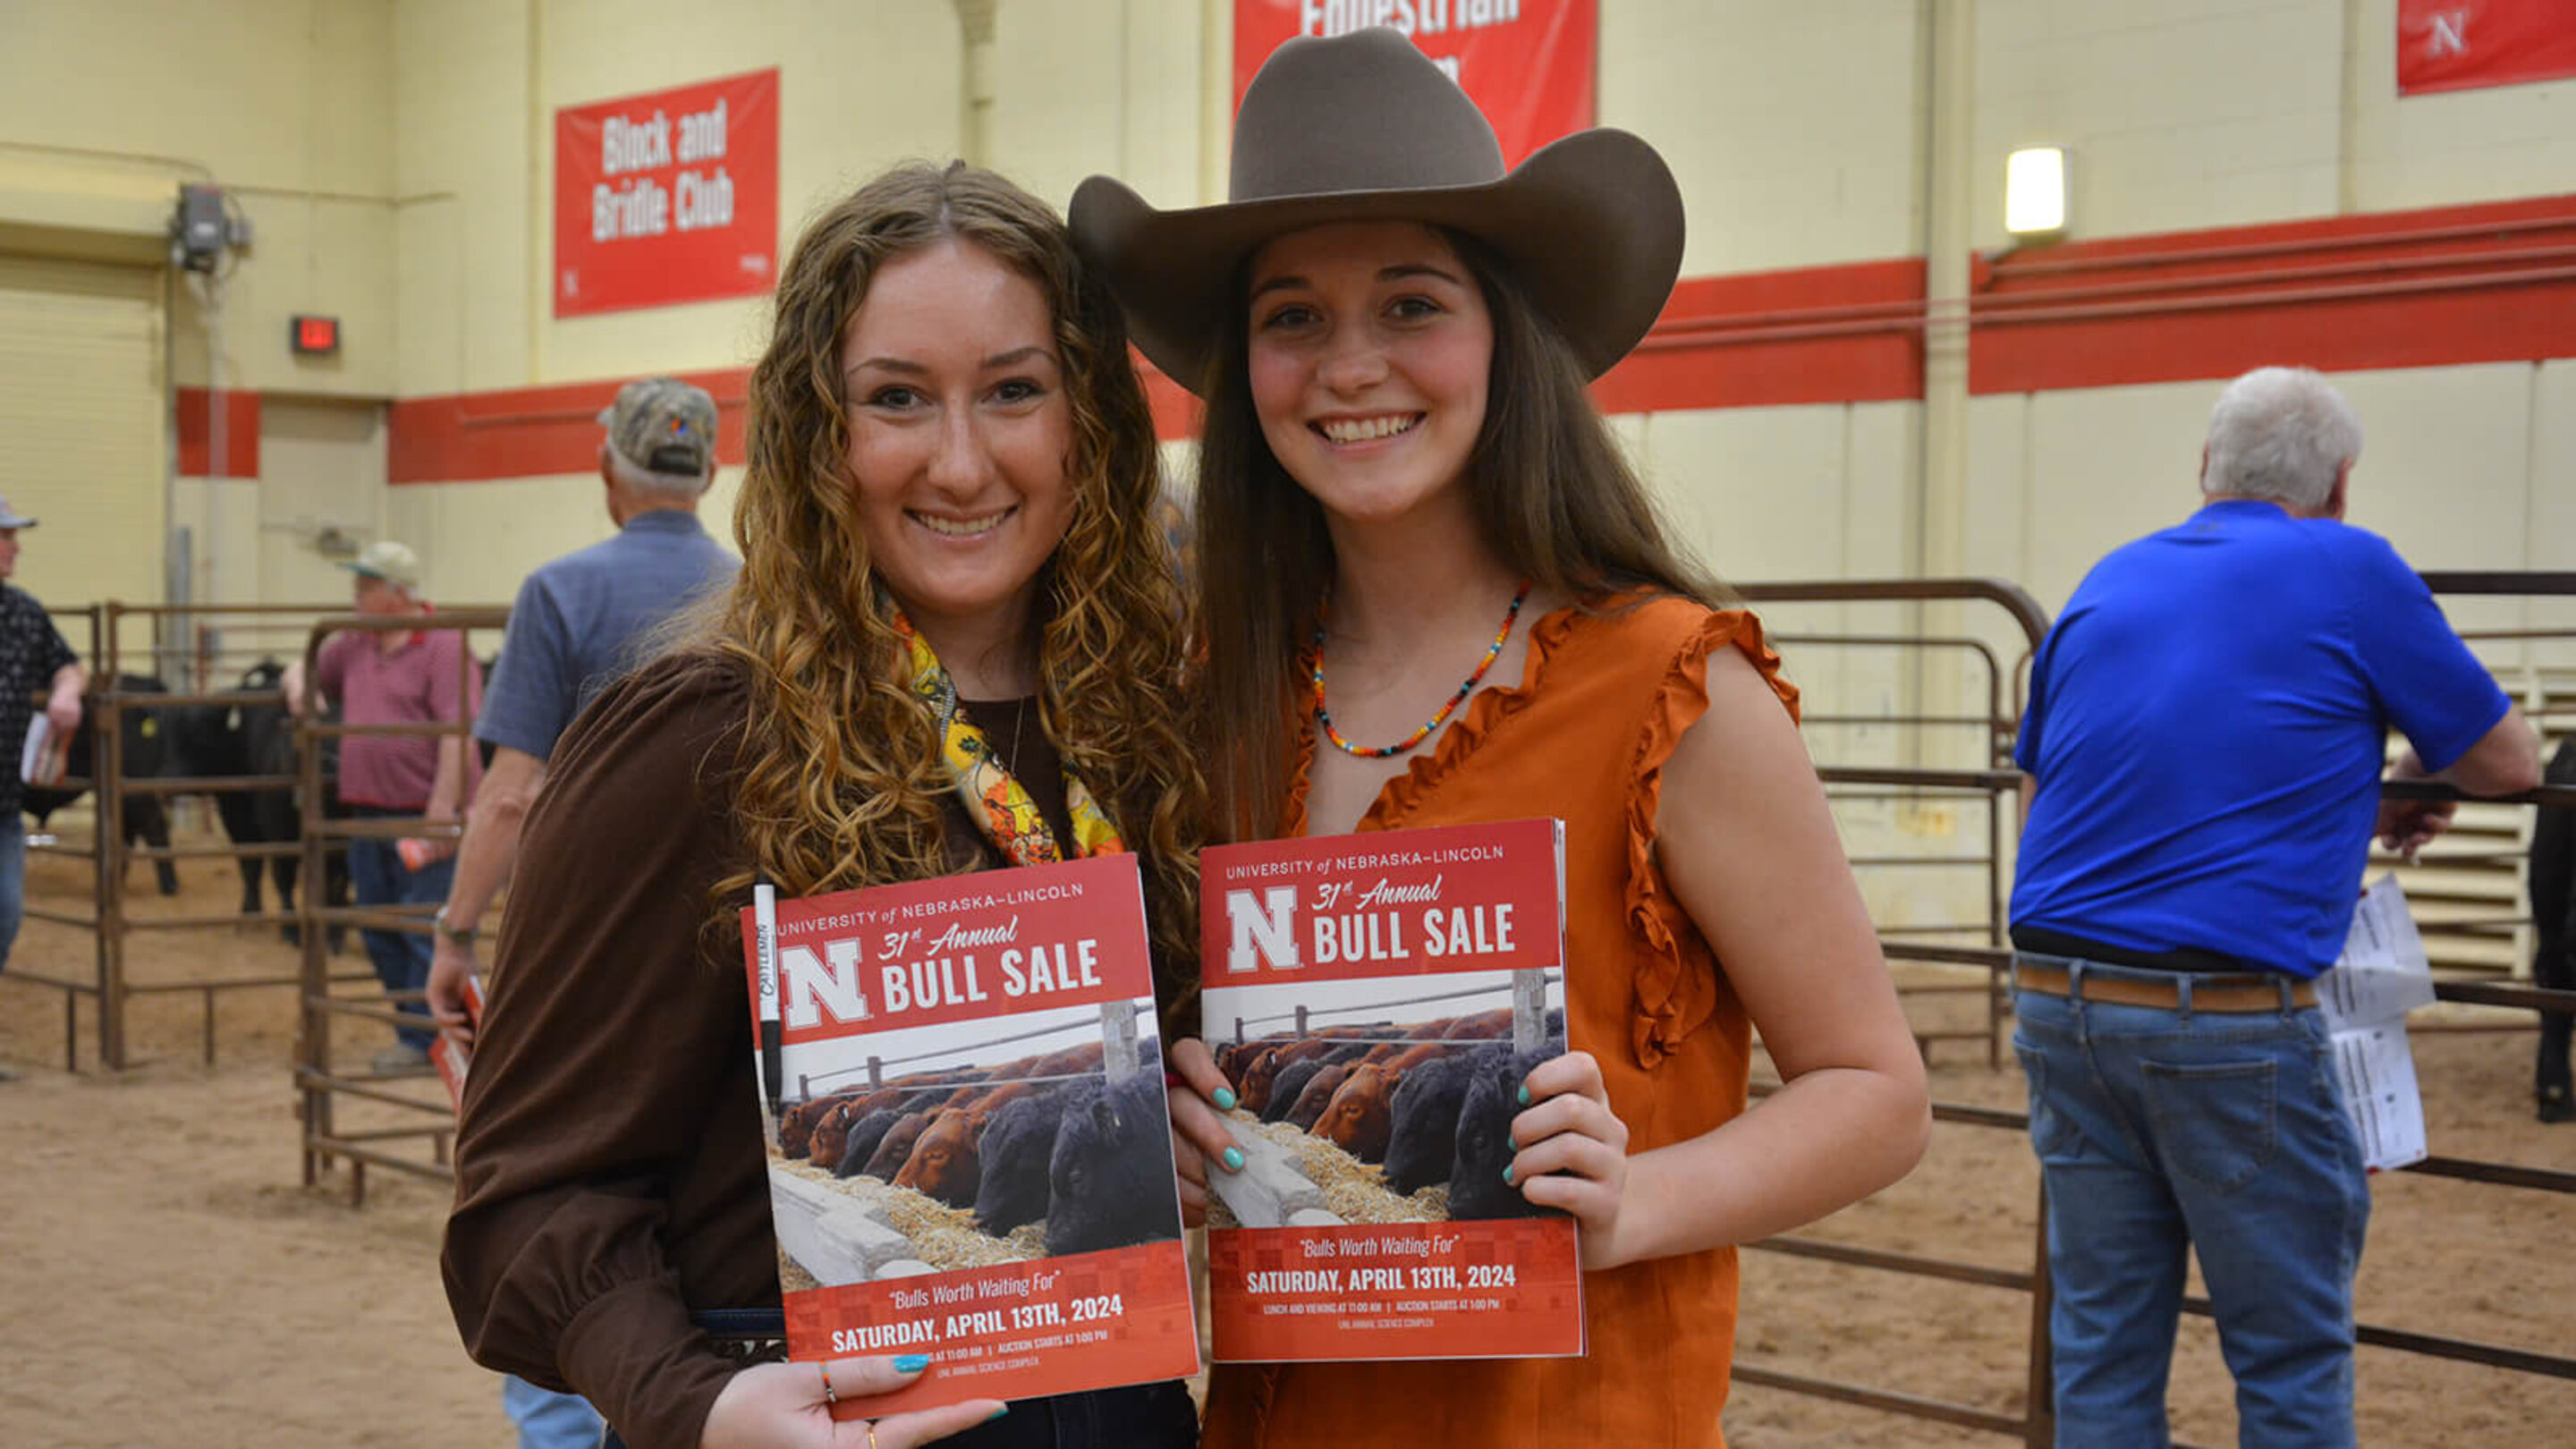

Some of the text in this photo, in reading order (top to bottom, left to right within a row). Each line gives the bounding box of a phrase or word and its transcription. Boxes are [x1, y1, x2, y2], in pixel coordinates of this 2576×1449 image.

[603, 97, 727, 175] Block and
[593, 166, 733, 243] Bridle Club
[1225, 860, 1314, 879] UNIVERSITY
[1317, 859, 1332, 876] of
[1355, 873, 1443, 911] Annual
[777, 911, 877, 936] UNIVERSITY
[882, 908, 898, 925] of
[926, 914, 1018, 956] Annual
[1225, 886, 1300, 974] N
[1313, 903, 1516, 964] BULL SALE
[776, 936, 871, 1031] N
[881, 939, 1102, 1013] BULL SALE
[1339, 1238, 1377, 1257] Worth
[1381, 1236, 1429, 1258] Waiting
[933, 1283, 974, 1305] Worth
[978, 1275, 1030, 1297] Waiting
[1247, 1265, 1516, 1294] SATURDAY, APRIL 13TH, 2024
[831, 1293, 1124, 1353] SATURDAY, APRIL 13TH, 2024
